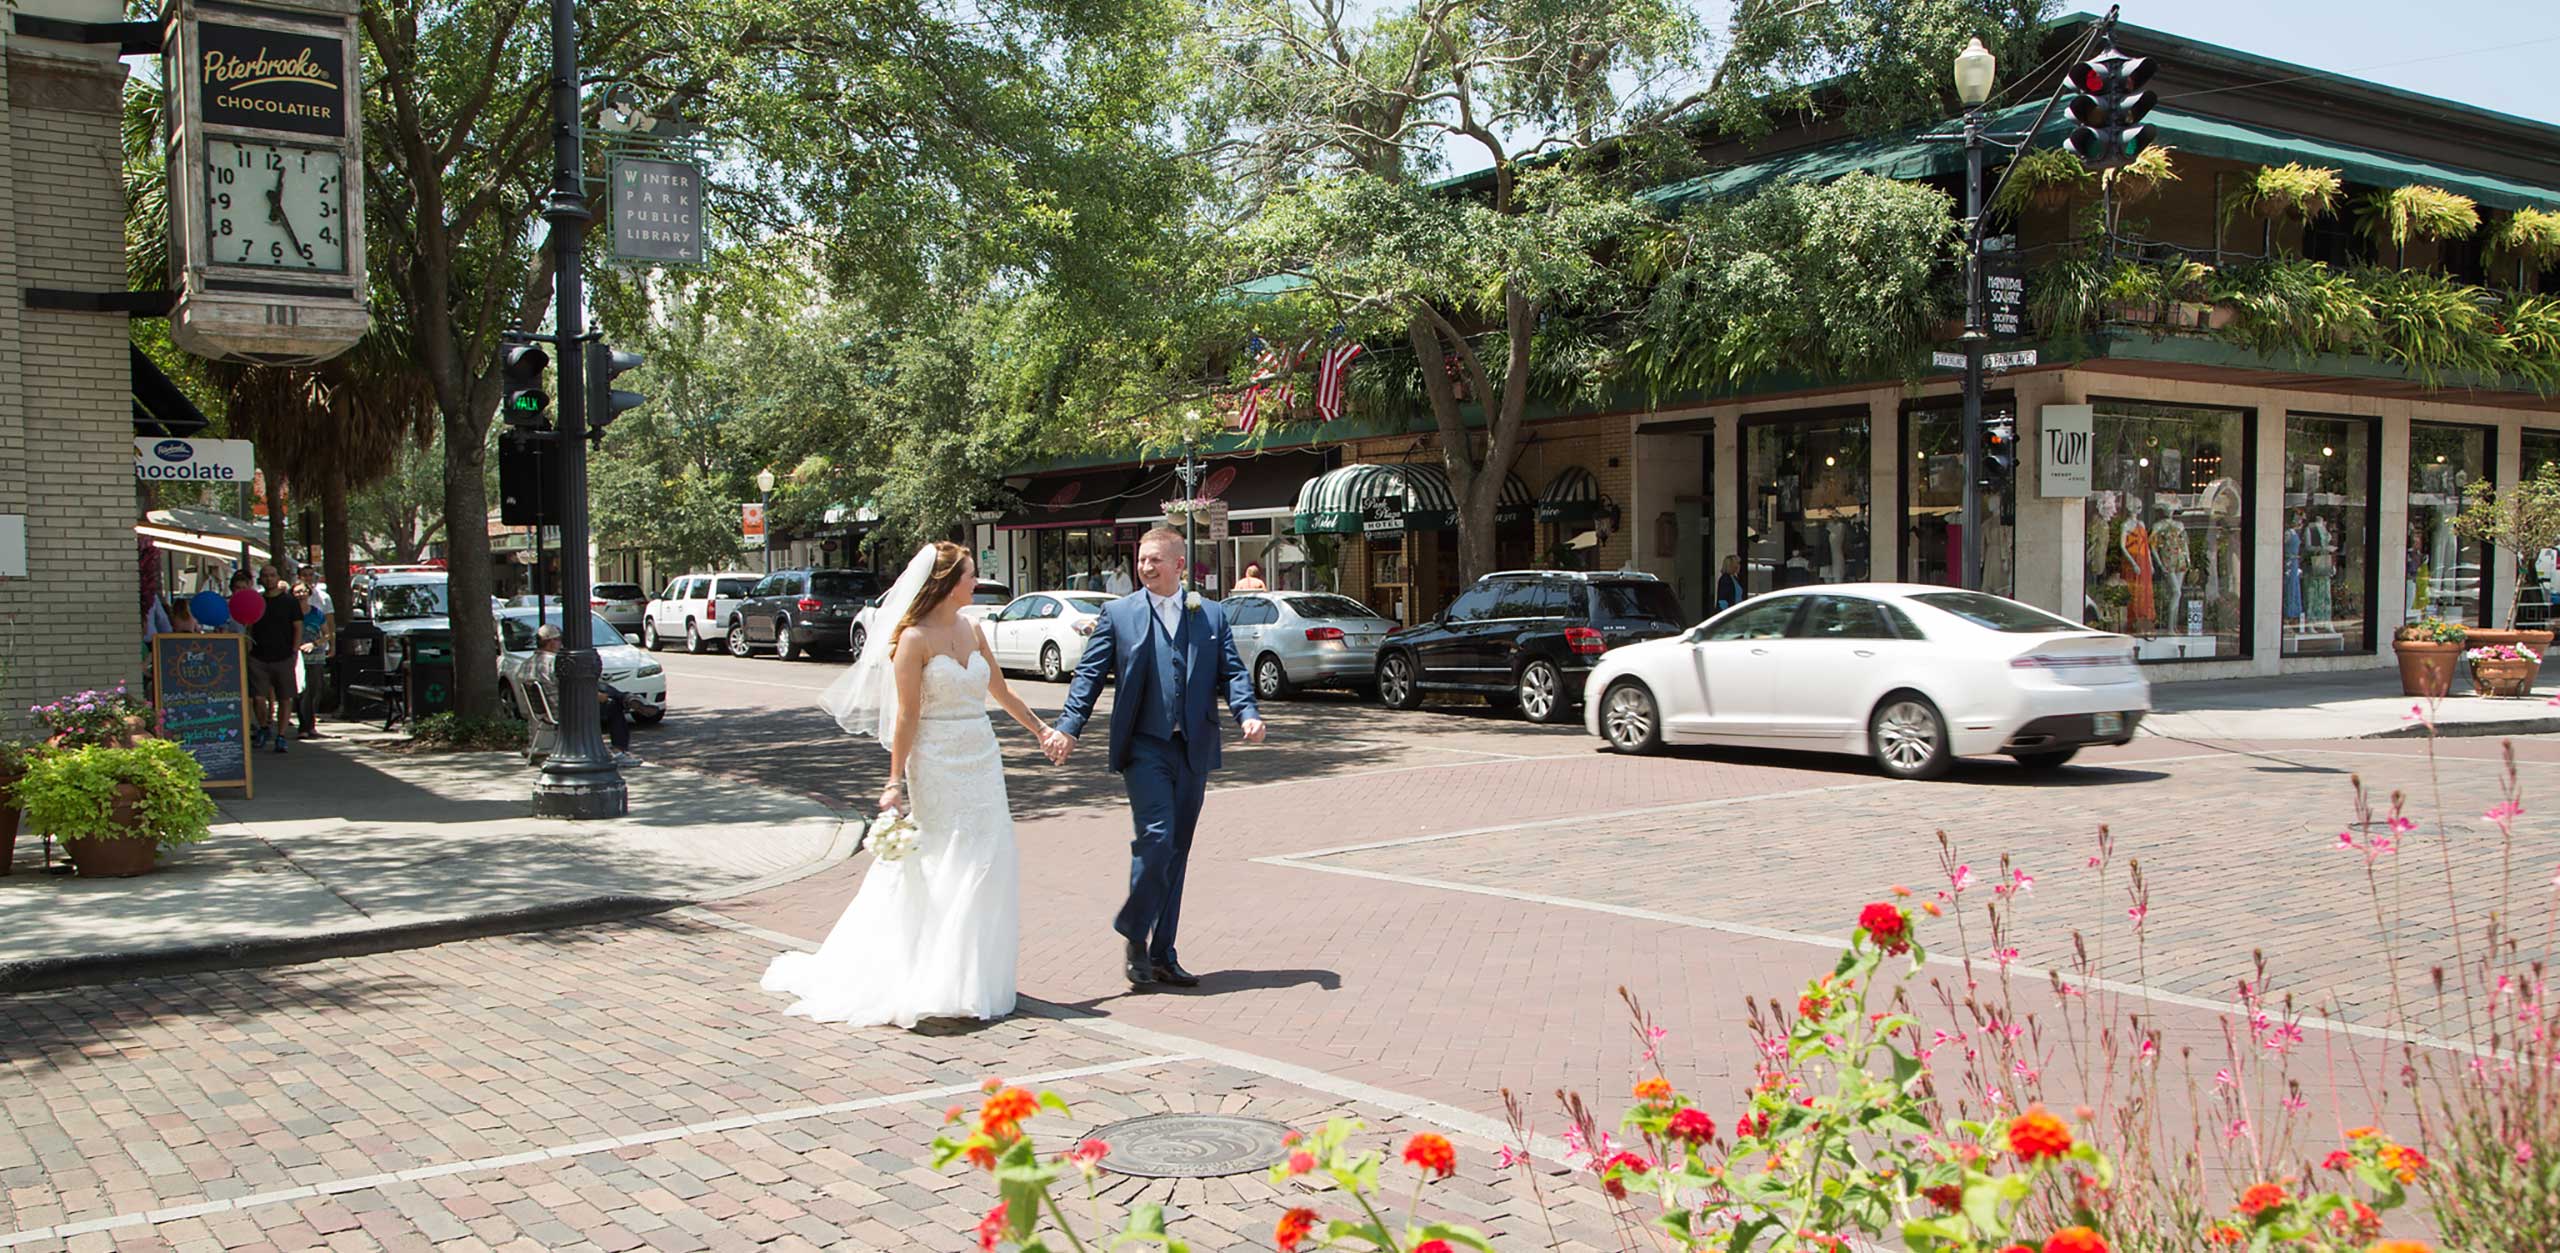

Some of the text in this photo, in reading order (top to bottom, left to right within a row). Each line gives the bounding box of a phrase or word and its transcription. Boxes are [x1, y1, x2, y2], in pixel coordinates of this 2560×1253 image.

[204, 47, 322, 84] Peterbrooke
[217, 95, 331, 119] CHOCOLATIER
[237, 151, 251, 168] 11
[266, 153, 281, 171] 12
[301, 156, 306, 173] 1
[217, 167, 234, 185] 10
[624, 169, 688, 187] WINTER
[319, 177, 329, 194] 2
[218, 193, 231, 210] 9
[626, 190, 688, 206] PARK
[319, 203, 330, 219] 3
[627, 210, 689, 224] PUBLIC
[220, 218, 233, 235] 8
[319, 226, 332, 244] 4
[627, 229, 690, 243] LIBRARY
[242, 239, 253, 255] 7
[271, 241, 283, 258] 6
[302, 244, 313, 260] 5
[136, 462, 234, 479] hocolate
[1363, 498, 1388, 510] Park
[1311, 514, 1338, 529] Hotel
[1374, 507, 1401, 520] Plaza
[1368, 520, 1399, 529] HOTEL
